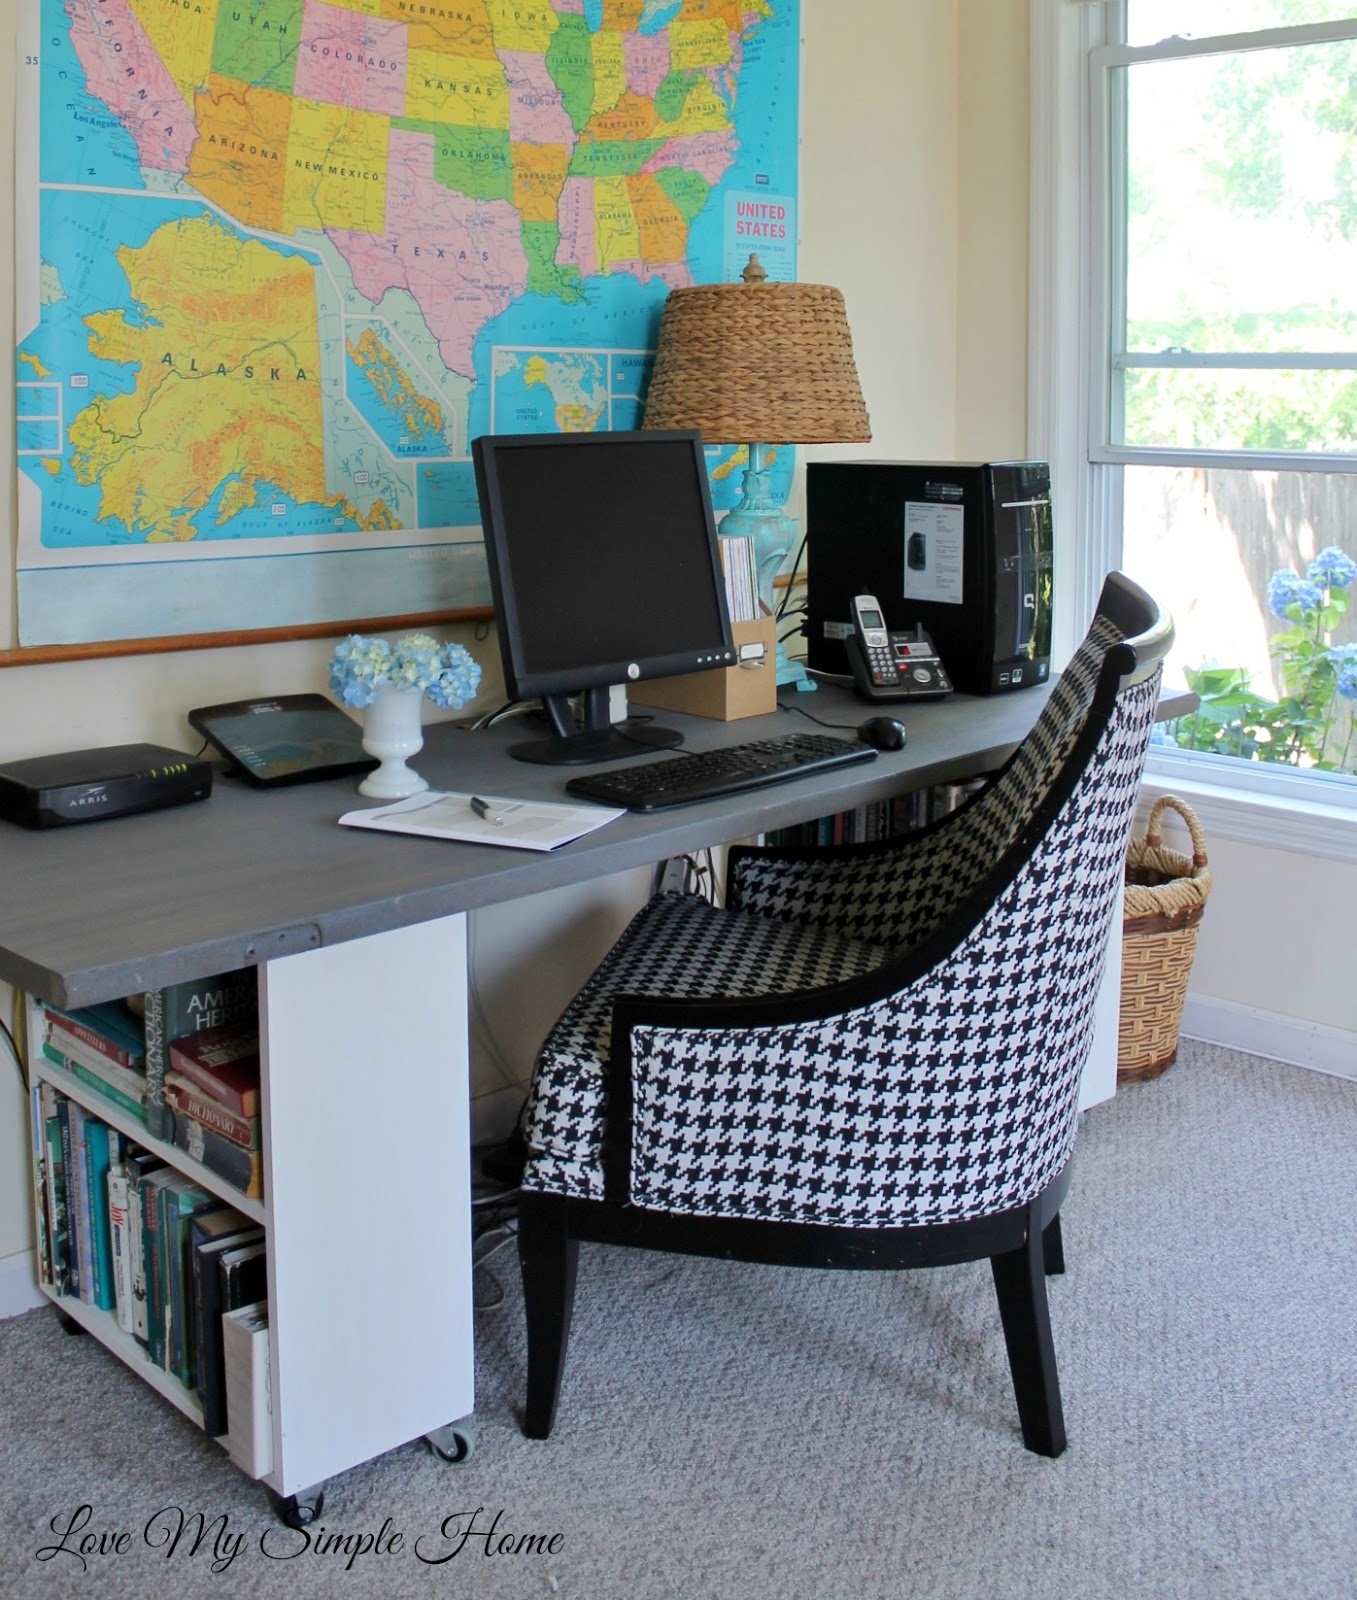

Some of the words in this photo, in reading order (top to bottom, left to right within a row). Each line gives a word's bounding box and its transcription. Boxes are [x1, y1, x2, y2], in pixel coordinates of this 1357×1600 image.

[399, 2, 472, 23] NEBRASKA
[502, 10, 547, 22] IOWA
[232, 11, 287, 35] UTAH
[25, 56, 39, 65] 35
[311, 44, 397, 71] COLORADO
[551, 57, 588, 65] ILLINOIS
[424, 79, 493, 97] KANSAS
[517, 96, 561, 106] MISSOURI
[687, 102, 726, 113] VIRGINIA
[208, 134, 278, 161] ARIZONA
[442, 149, 507, 162] OKLAHOMA
[295, 160, 322, 171] NEW
[328, 166, 379, 181] MEXICO
[518, 172, 562, 180] ARKANSAS
[599, 212, 631, 220] ALABAMA
[737, 202, 785, 219] UNITED
[643, 215, 678, 226] GEORGIA
[736, 220, 785, 239] STATES
[391, 244, 489, 261] TEXAS
[161, 352, 306, 381] ALASKA
[397, 445, 427, 453] ALASKA
[69, 793, 109, 808] ARRIS
[152, 988, 164, 1047] MERICAN
[145, 992, 158, 1108] CTIONARY
